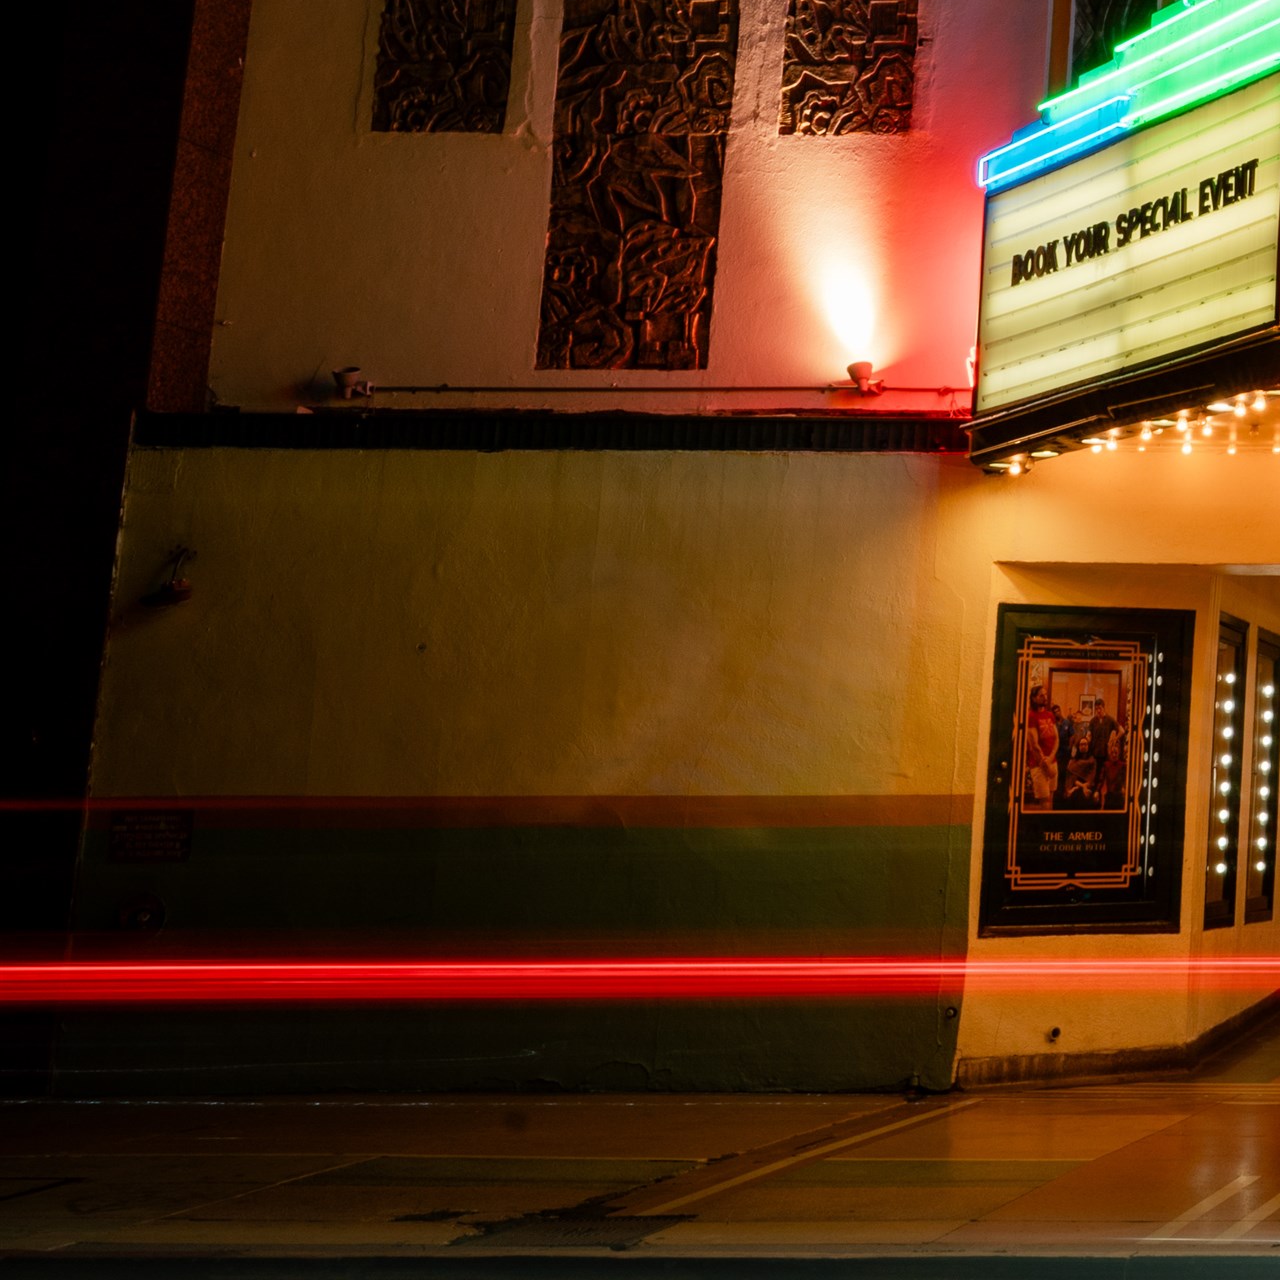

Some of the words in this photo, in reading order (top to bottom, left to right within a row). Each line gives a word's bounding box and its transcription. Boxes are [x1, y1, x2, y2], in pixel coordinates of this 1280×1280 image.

[1011, 239, 1060, 287] BOOK
[1063, 220, 1111, 268] YOUR
[1116, 187, 1194, 248] SPECIAL
[1198, 158, 1260, 216] EVENT
[1044, 831, 1063, 841] THE
[1068, 831, 1103, 841] ARMED
[1040, 843, 1082, 852] OCTOBER
[1085, 842, 1106, 852] 19TH
